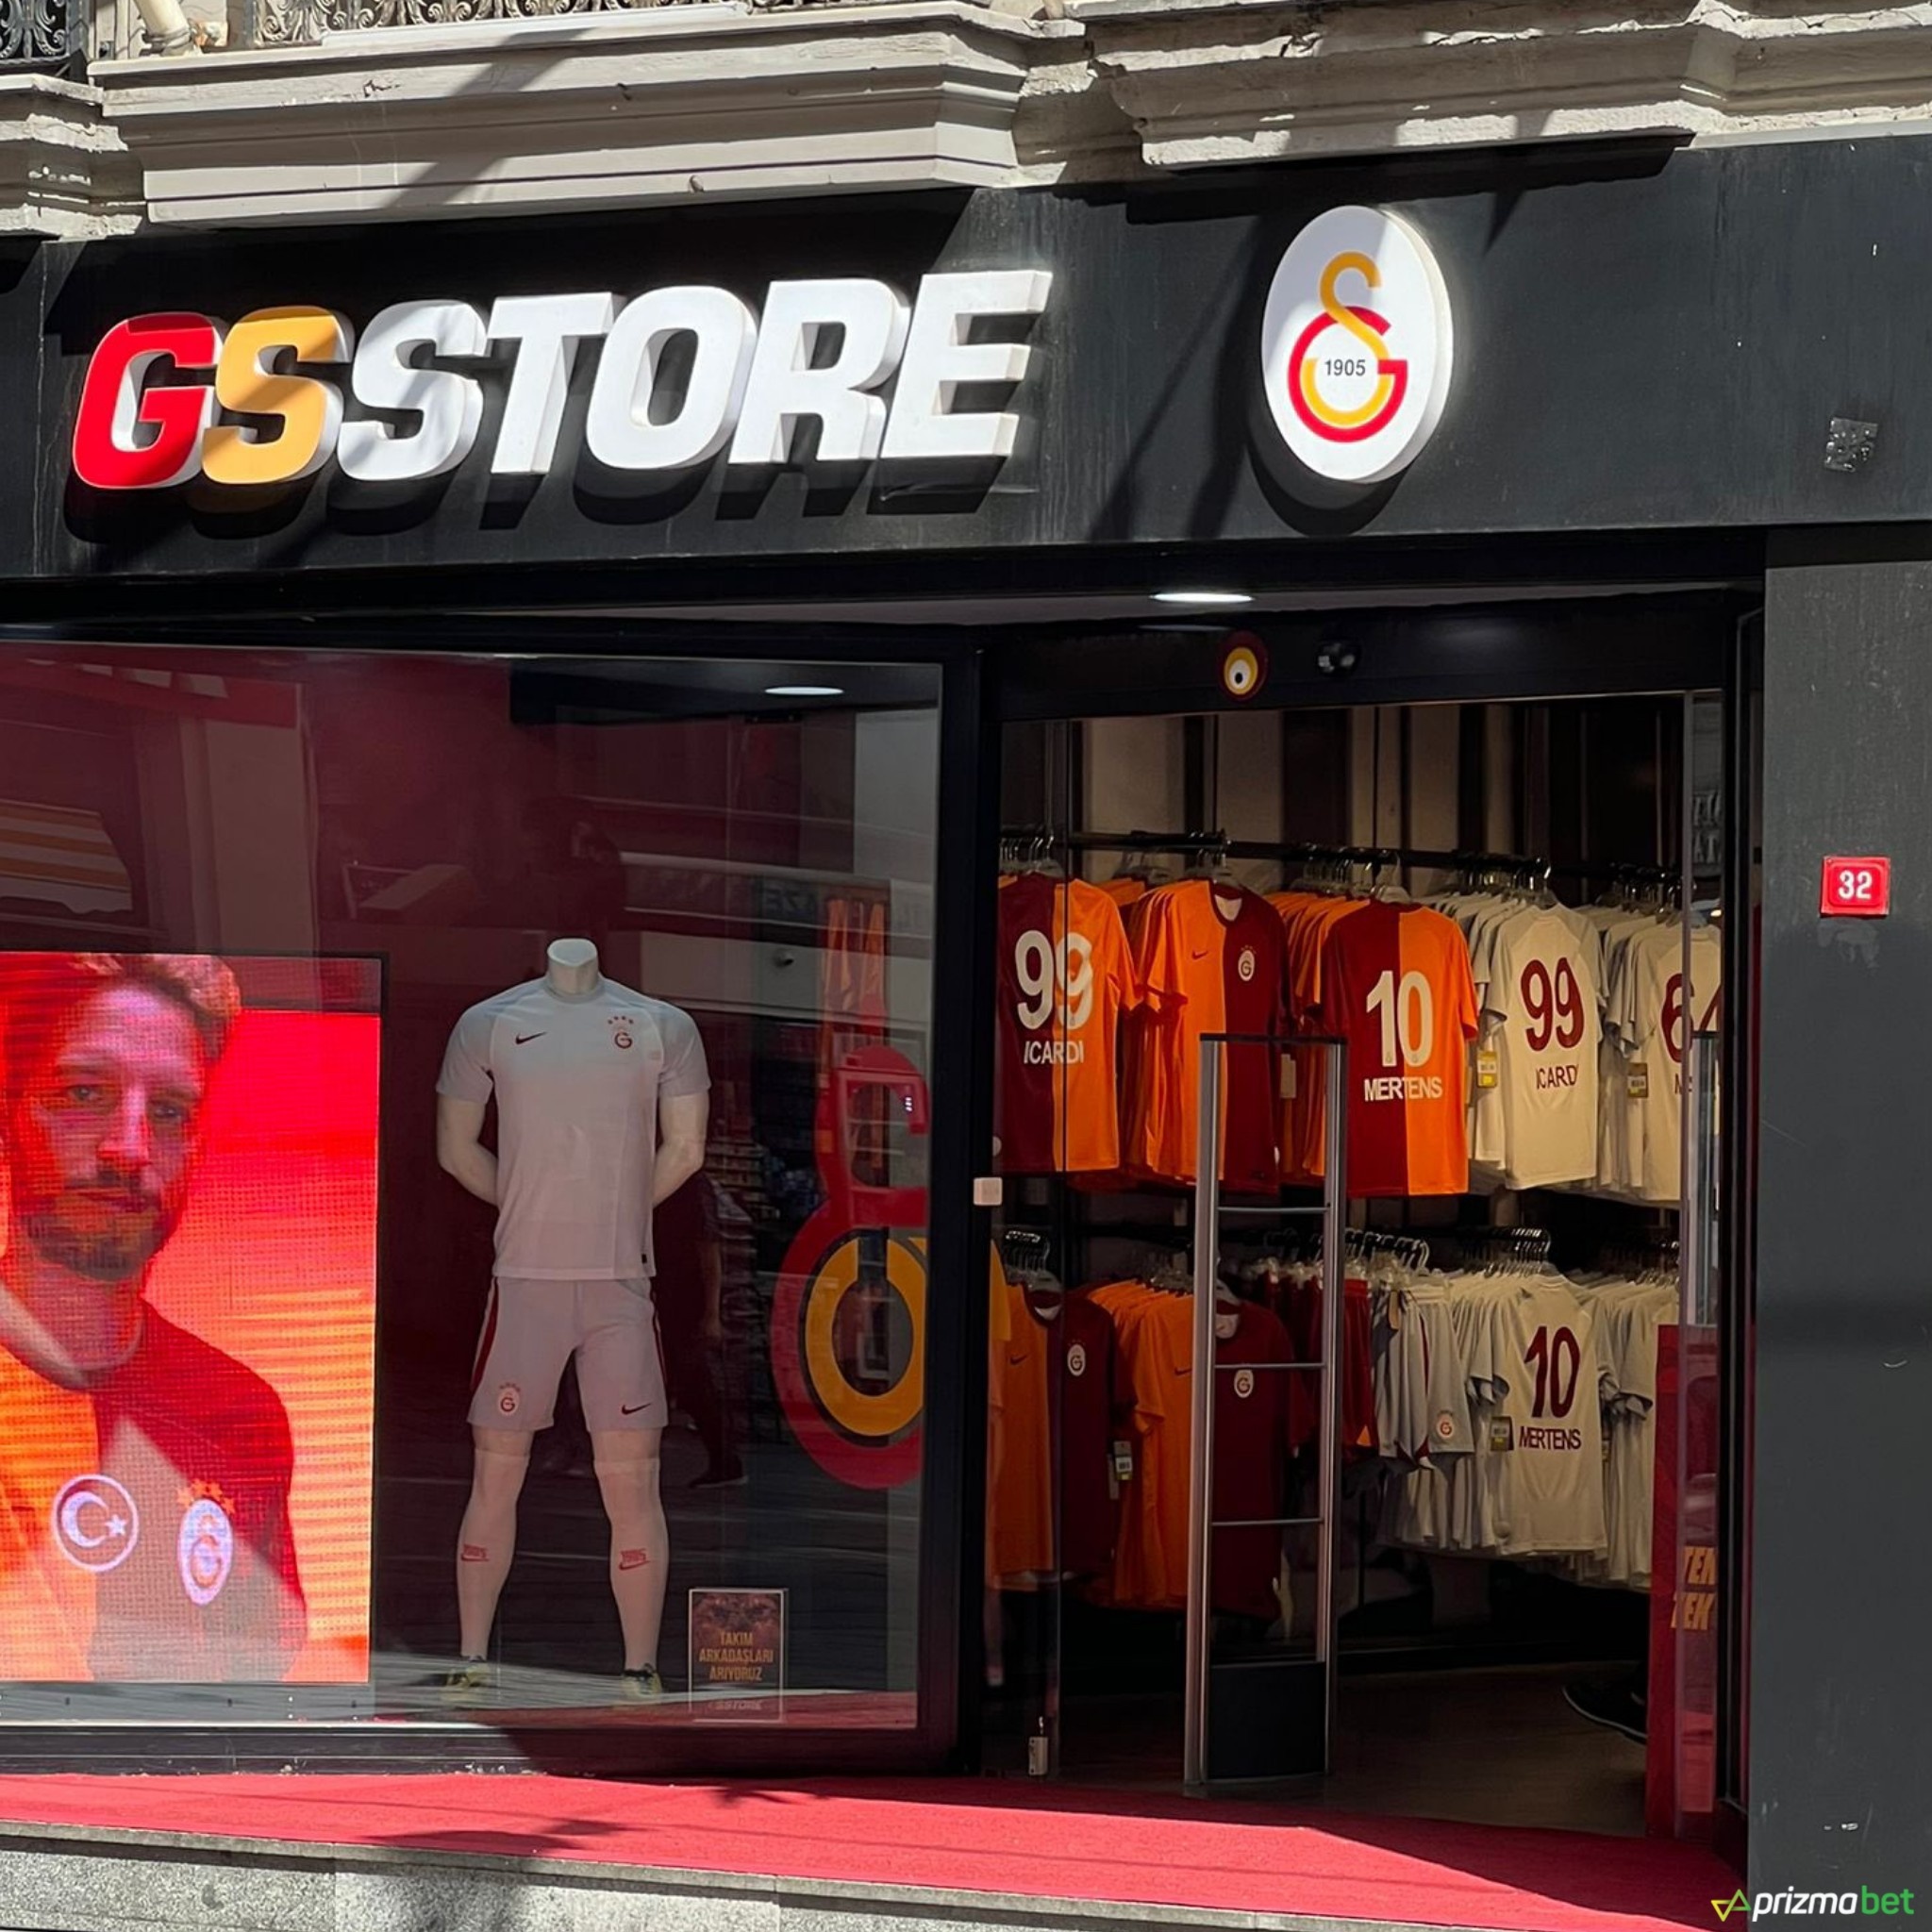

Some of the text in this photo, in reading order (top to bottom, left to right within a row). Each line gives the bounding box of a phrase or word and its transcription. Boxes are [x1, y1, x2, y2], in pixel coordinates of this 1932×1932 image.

[1324, 358, 1366, 376] 1905
[1838, 870, 1873, 900] 32
[1014, 930, 1094, 1030] 99
[1520, 957, 1585, 1052] 99
[1366, 970, 1434, 1068] 10
[1024, 1041, 1084, 1065] ICARDI
[1364, 1076, 1443, 1103] MERTENS
[1536, 1064, 1579, 1091] ICARD
[1524, 1325, 1581, 1419] 10
[1519, 1425, 1582, 1451] MERTENS
[719, 1631, 754, 1646] TAKIM
[708, 1666, 763, 1681] ARIYORUZ
